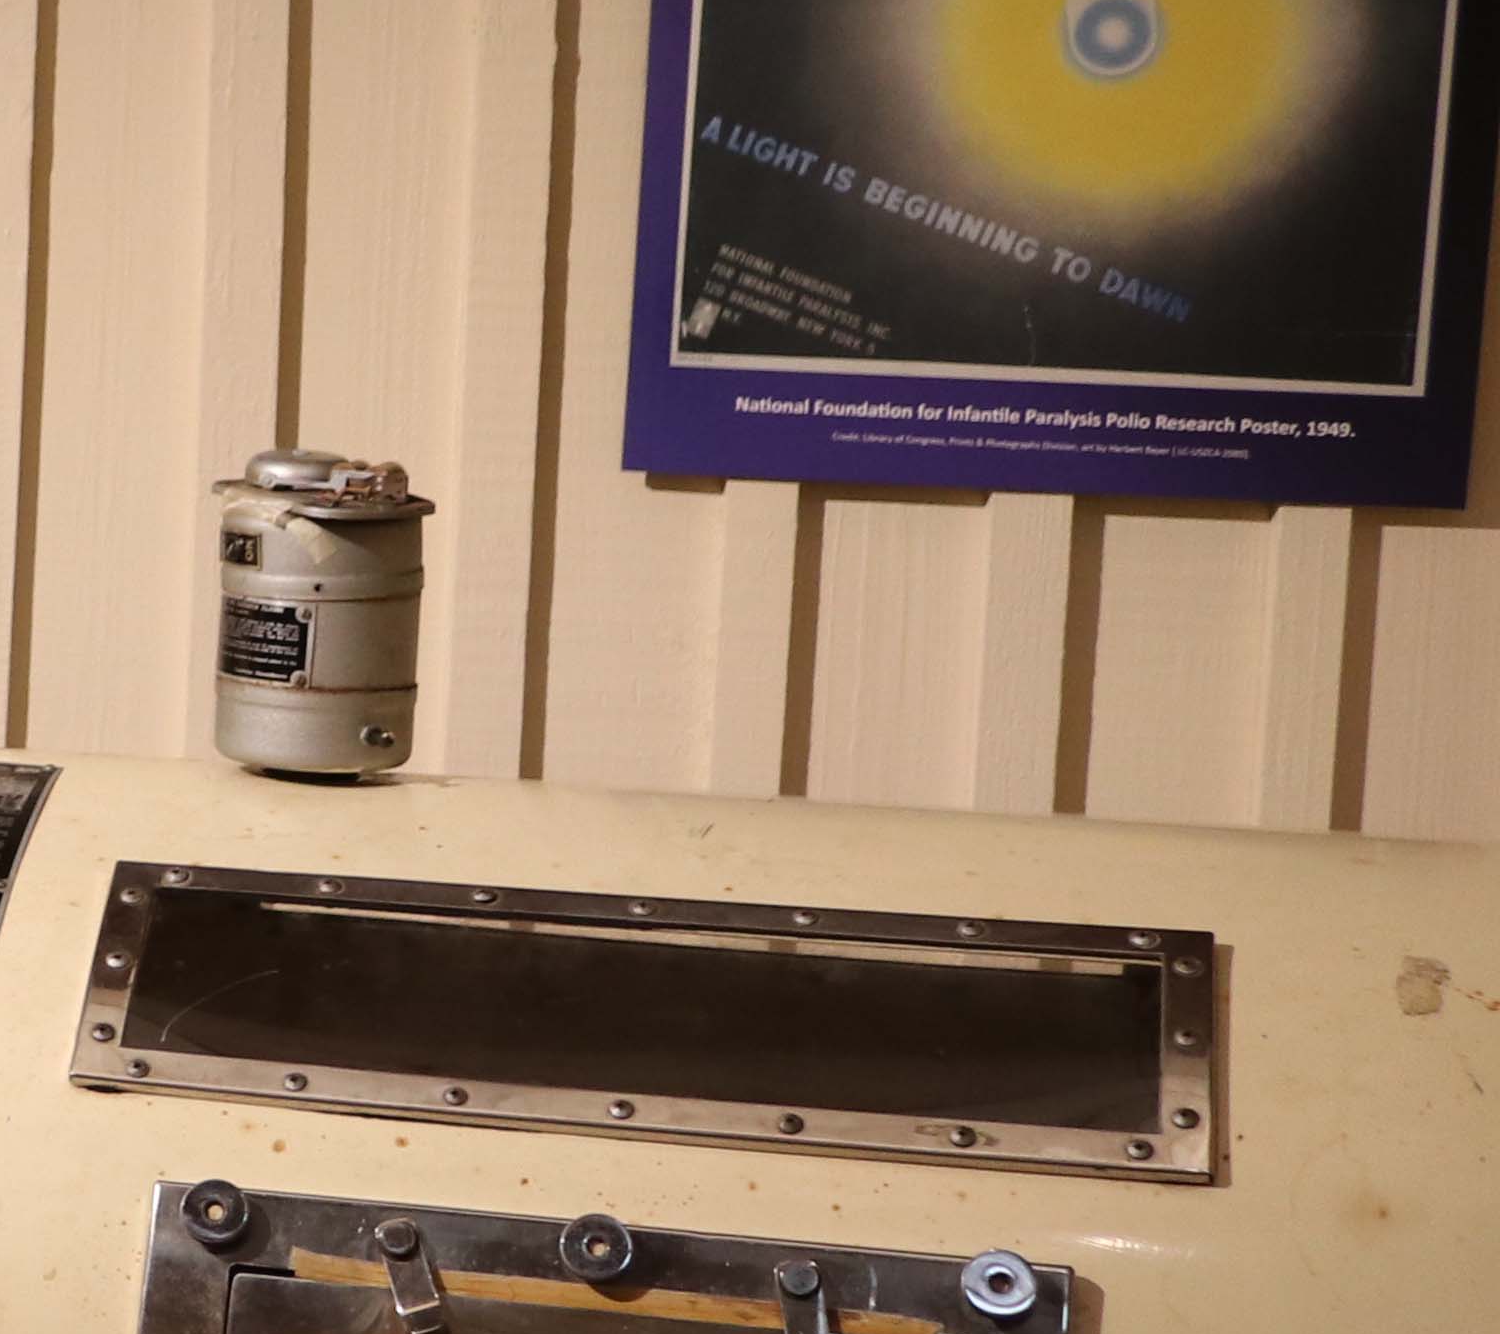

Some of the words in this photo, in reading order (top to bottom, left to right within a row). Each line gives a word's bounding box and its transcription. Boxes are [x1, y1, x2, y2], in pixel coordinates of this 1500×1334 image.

[701, 115, 723, 144] A
[727, 123, 819, 176] LIGHT
[822, 162, 857, 193] IS
[863, 176, 1040, 263] BEGINNING
[1050, 246, 1092, 283] TO
[1099, 267, 1194, 322] DAWN
[711, 262, 734, 280] FOR
[738, 271, 796, 303] INFANTILE
[798, 294, 861, 328] PARALYSIS
[719, 243, 775, 275] NATIONAL
[780, 266, 852, 304] FOUNDATION
[796, 315, 825, 335] NEW
[830, 329, 861, 350] YORK
[734, 394, 809, 416] National
[813, 397, 912, 420] Foundation
[916, 401, 943, 421] for
[947, 402, 1020, 424] Infantile
[1025, 405, 1101, 430] Paralysis
[1105, 409, 1150, 430] Polio
[1156, 411, 1235, 434] Research
[1241, 414, 1301, 438] Poster,
[1305, 419, 1356, 439] 1949.
